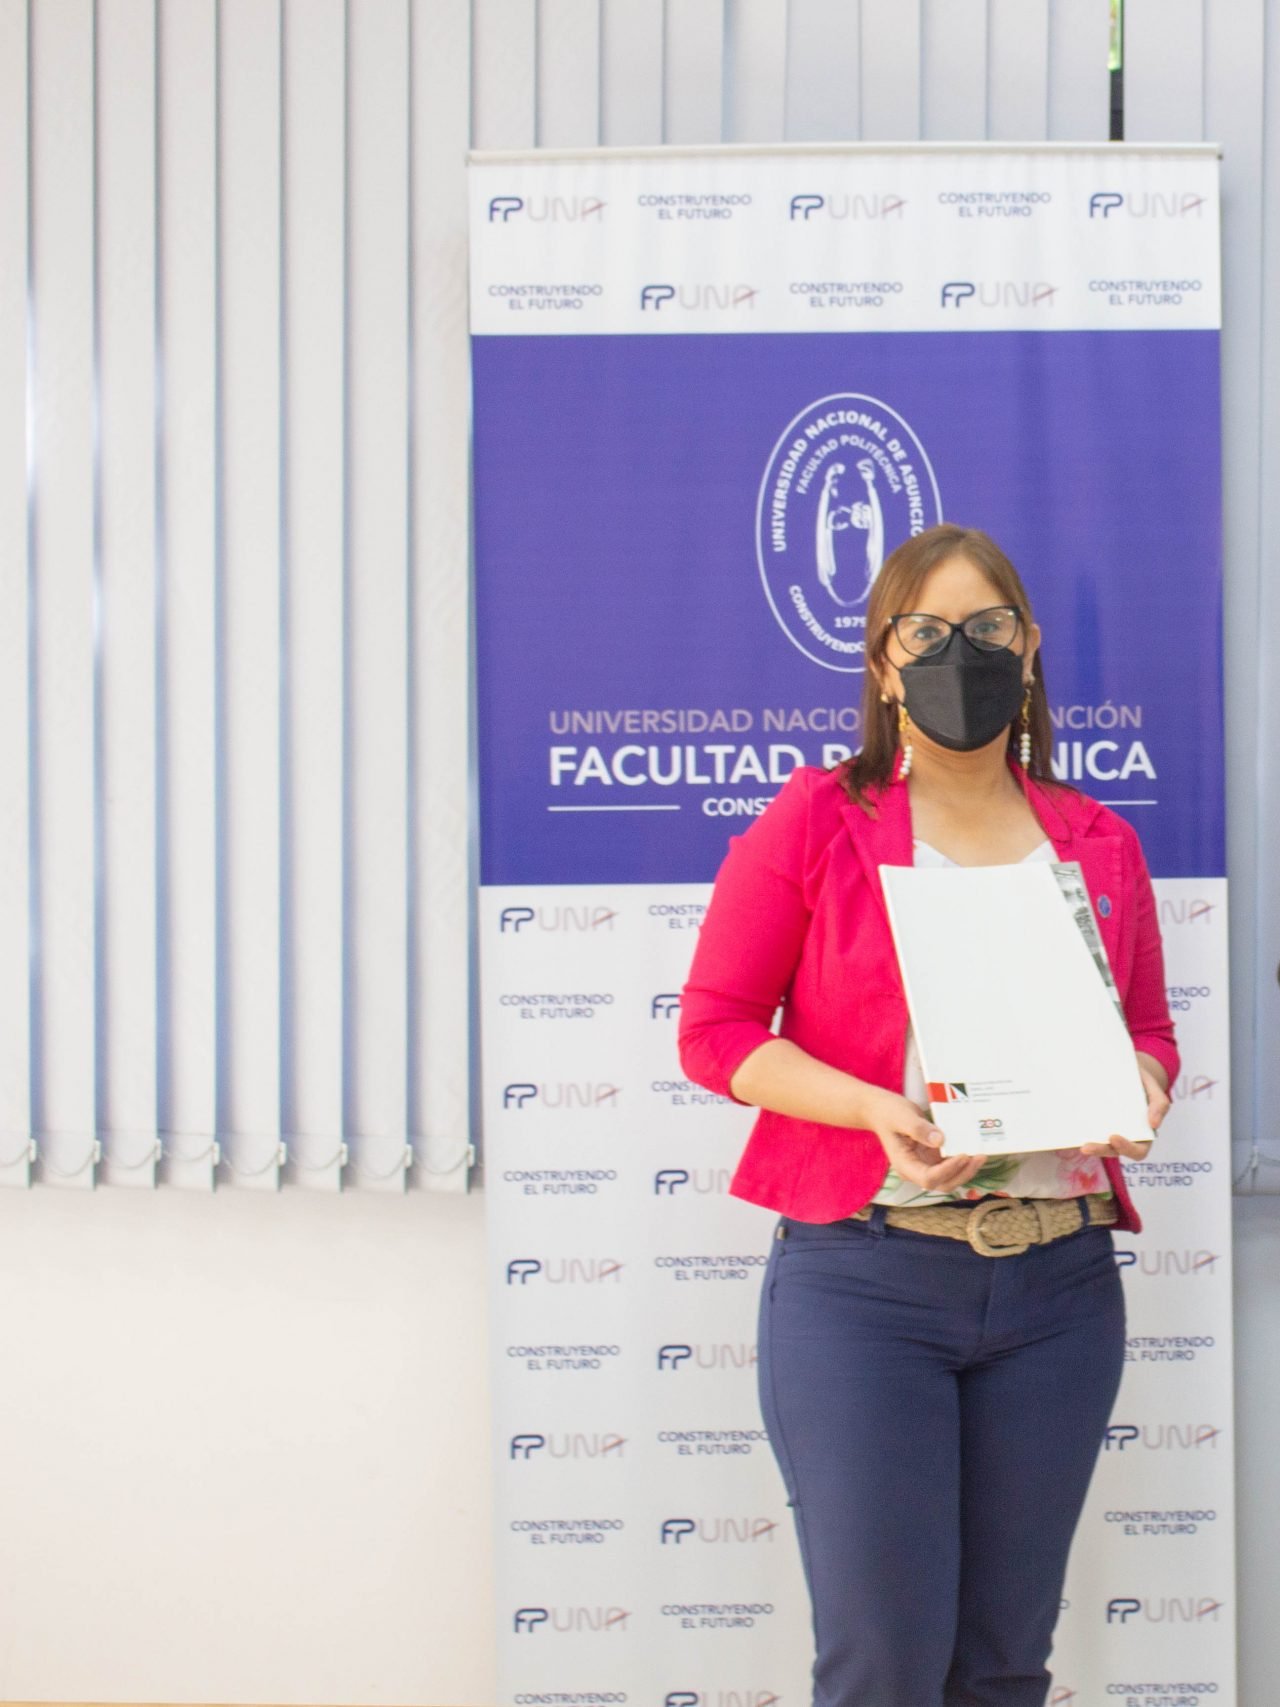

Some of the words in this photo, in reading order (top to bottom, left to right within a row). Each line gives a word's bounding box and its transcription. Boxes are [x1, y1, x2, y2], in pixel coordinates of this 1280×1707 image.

[638, 194, 752, 207] CONSTRUYENDO
[938, 192, 1051, 205] CONSTRUYENDO
[658, 208, 673, 220] EL
[677, 208, 733, 220] FUTURO
[958, 205, 974, 217] EL
[978, 205, 1032, 217] FUTURO
[488, 285, 603, 297] CONSTRUYENDO
[790, 282, 903, 294] CONSTRUYENDO
[1089, 280, 1202, 292] CONSTRUYENDO
[508, 299, 525, 310] EL
[528, 299, 583, 310] FUTURO
[809, 296, 825, 308] EL
[829, 296, 884, 308] FUTURO
[1109, 294, 1124, 305] EL
[1128, 294, 1183, 305] FUTURO
[795, 438, 839, 495] FACULTAD
[771, 439, 809, 552] UNIVERSIDAD
[804, 411, 888, 441] NACIONAL
[886, 438, 908, 461] DE
[549, 708, 753, 734] UNIVERSIDAD
[763, 708, 861, 732] NACIO
[1049, 699, 1142, 729] NCIÓN
[549, 744, 806, 786] FACULTAD
[668, 918, 684, 929] EL
[500, 994, 614, 1006] CONSTRUYENDO
[520, 1007, 536, 1019] EL
[540, 1007, 594, 1018] FUTURO
[671, 1094, 687, 1105] EL
[1120, 1162, 1213, 1174] NSTRUYENDO
[503, 1170, 617, 1182] CONSTRUYENDO
[1139, 1175, 1193, 1187] FUTURO
[523, 1183, 538, 1195] EL
[543, 1183, 598, 1194] FUTURO
[655, 1255, 768, 1267] CONSTRUYENDO
[675, 1269, 690, 1281] EL
[694, 1269, 748, 1280] FUTURO
[1125, 1336, 1215, 1349] NSTRUYENDO
[507, 1345, 620, 1357] CONSTRUYENDO
[1141, 1350, 1195, 1361] FUTURO
[527, 1358, 543, 1370] EL
[546, 1358, 601, 1370] FUTURO
[677, 1443, 693, 1455] EL
[697, 1443, 751, 1455] FUTURO
[1104, 1510, 1217, 1522] CONSTRUYENDO
[510, 1519, 624, 1532] CONSTRUYENDO
[1124, 1524, 1138, 1535] EL
[1142, 1524, 1198, 1535] FUTURO
[530, 1533, 546, 1545] EL
[550, 1532, 605, 1544] FUTURO
[661, 1603, 774, 1616] CONSTRUYENDO
[681, 1617, 696, 1629] EL
[700, 1616, 755, 1628] FUTURO
[1106, 1682, 1219, 1694] CONSTRUYENDO
[514, 1692, 628, 1705] CONSTRUYENDO
[1126, 1696, 1141, 1707] EL
[1144, 1696, 1199, 1707] FUTURO
